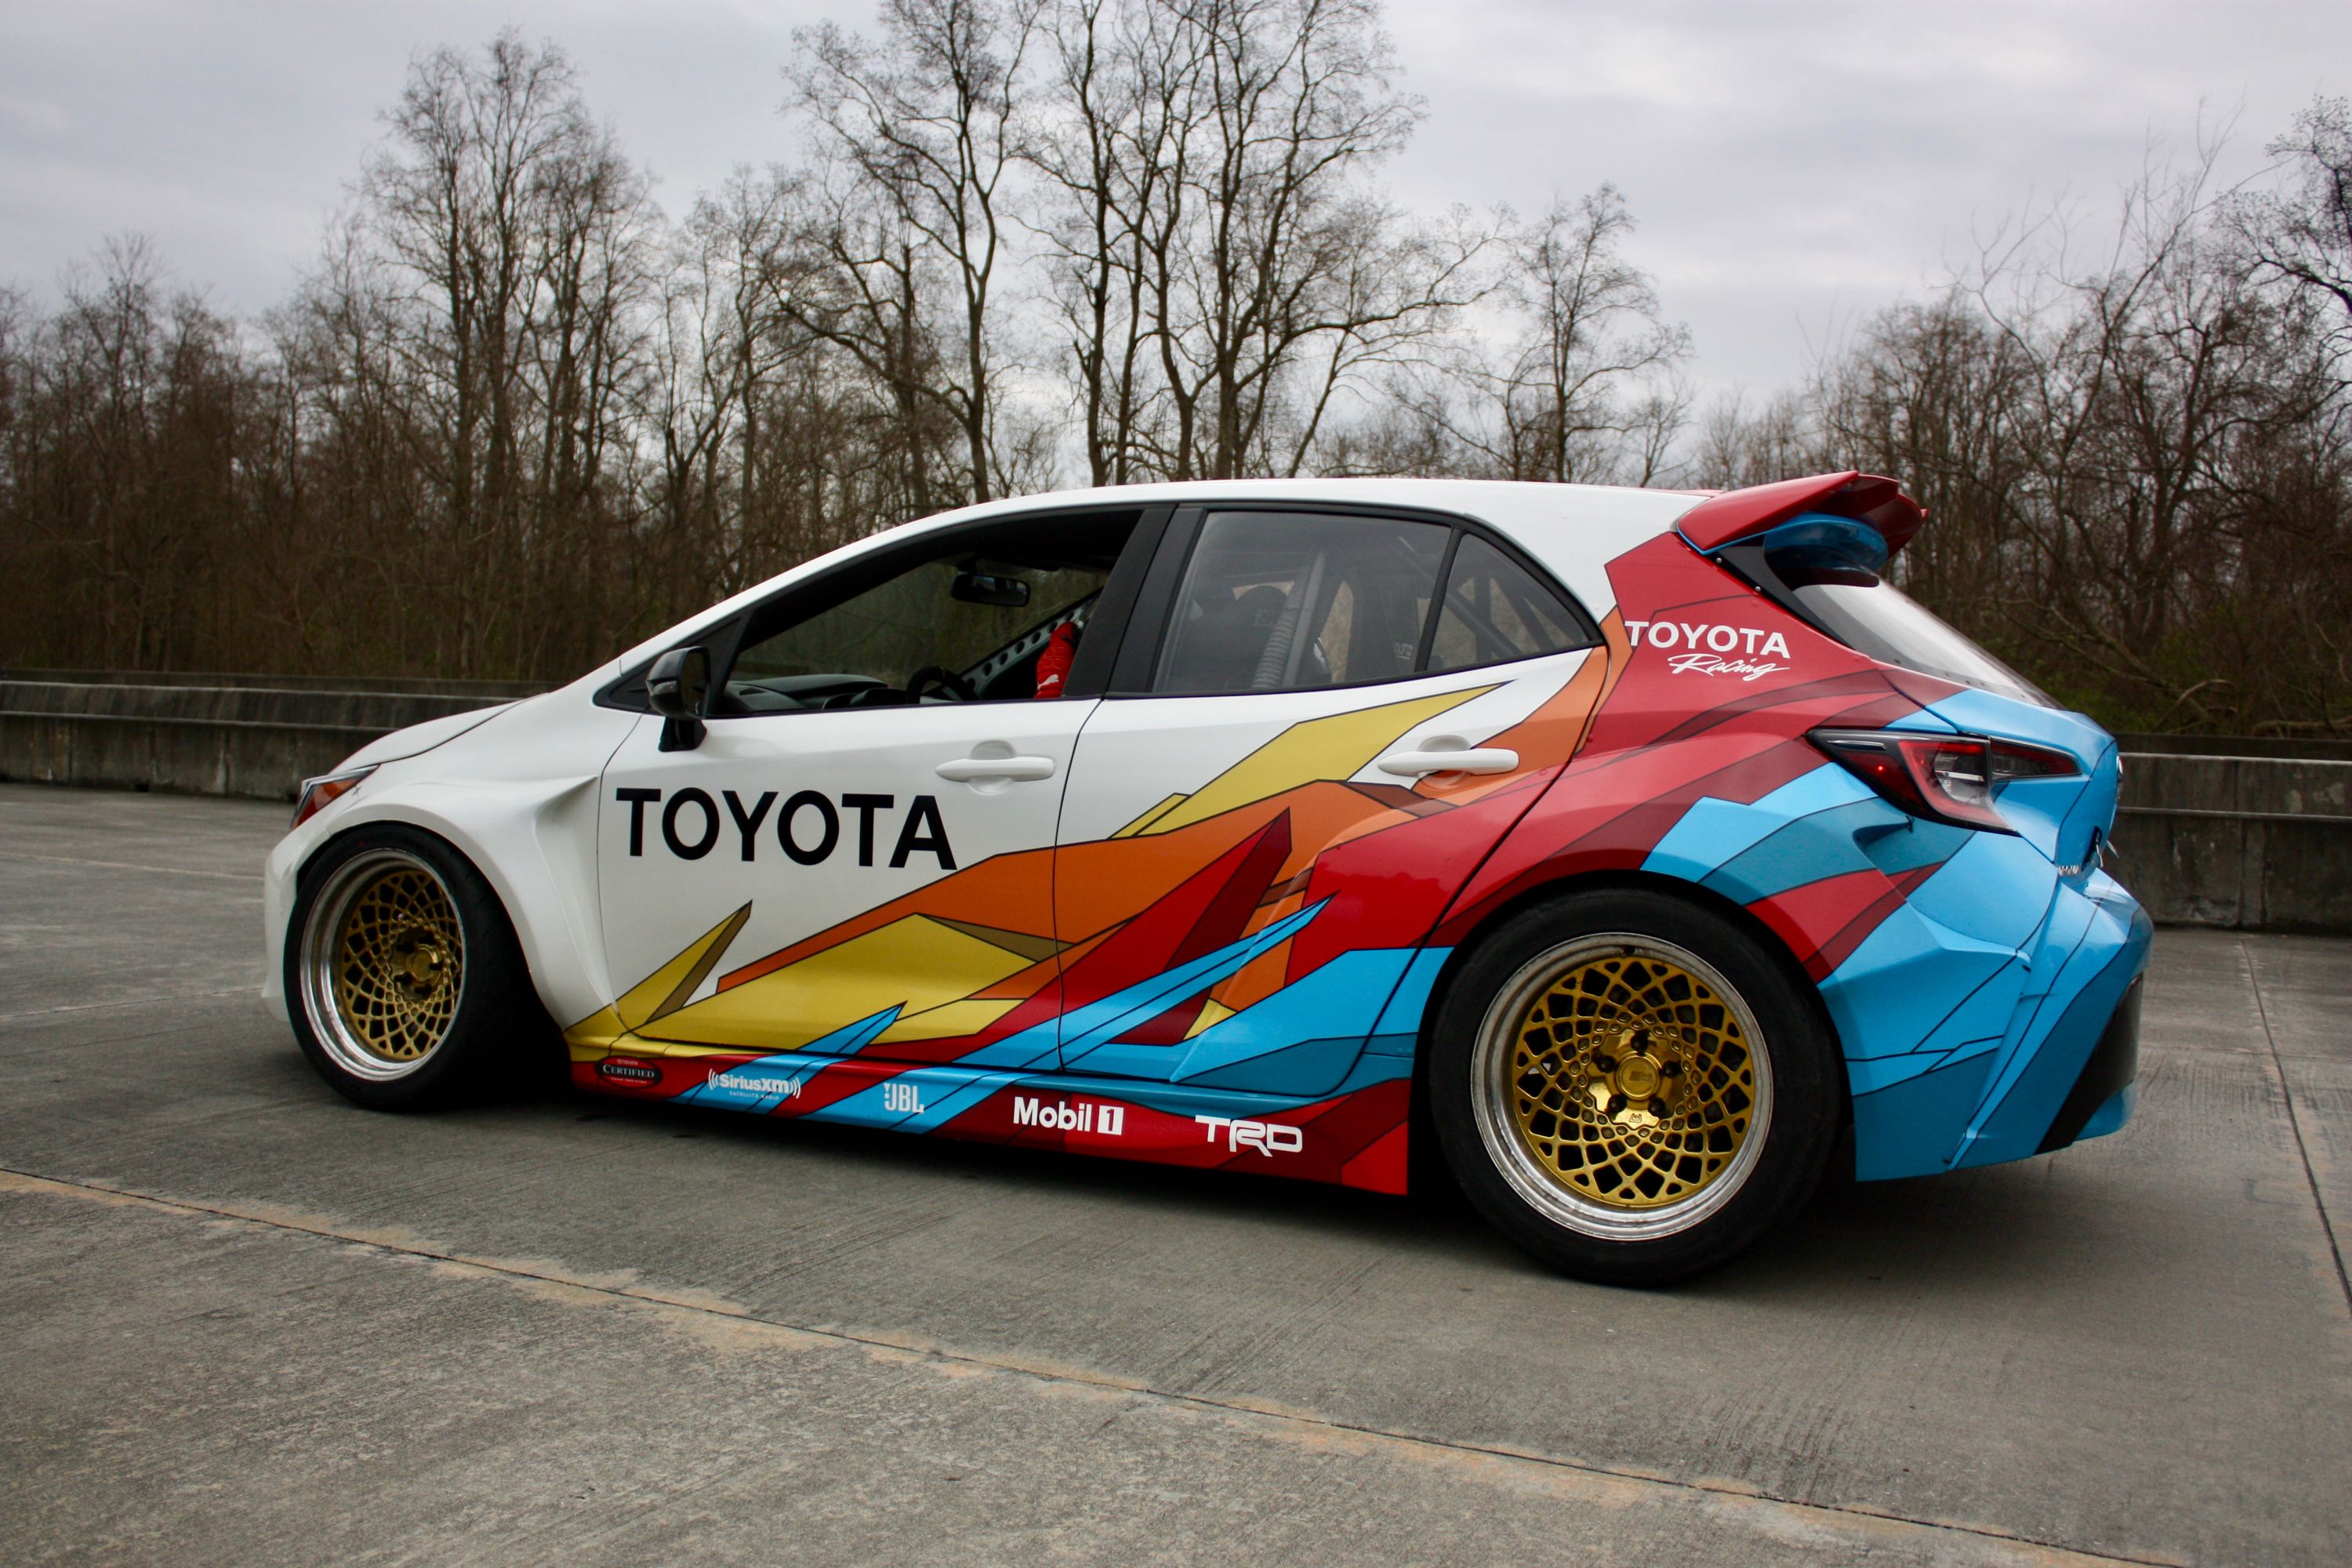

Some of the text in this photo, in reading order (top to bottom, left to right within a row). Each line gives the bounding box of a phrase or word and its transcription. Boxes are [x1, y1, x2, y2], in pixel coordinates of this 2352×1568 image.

[1624, 620, 1791, 659] TOYOTA
[1668, 653, 1790, 682] Racing
[616, 786, 958, 870] TOYOTA
[884, 1083, 924, 1112] JBL
[1013, 1096, 1123, 1135] Mobil 1
[1195, 1115, 1302, 1157] TRD
